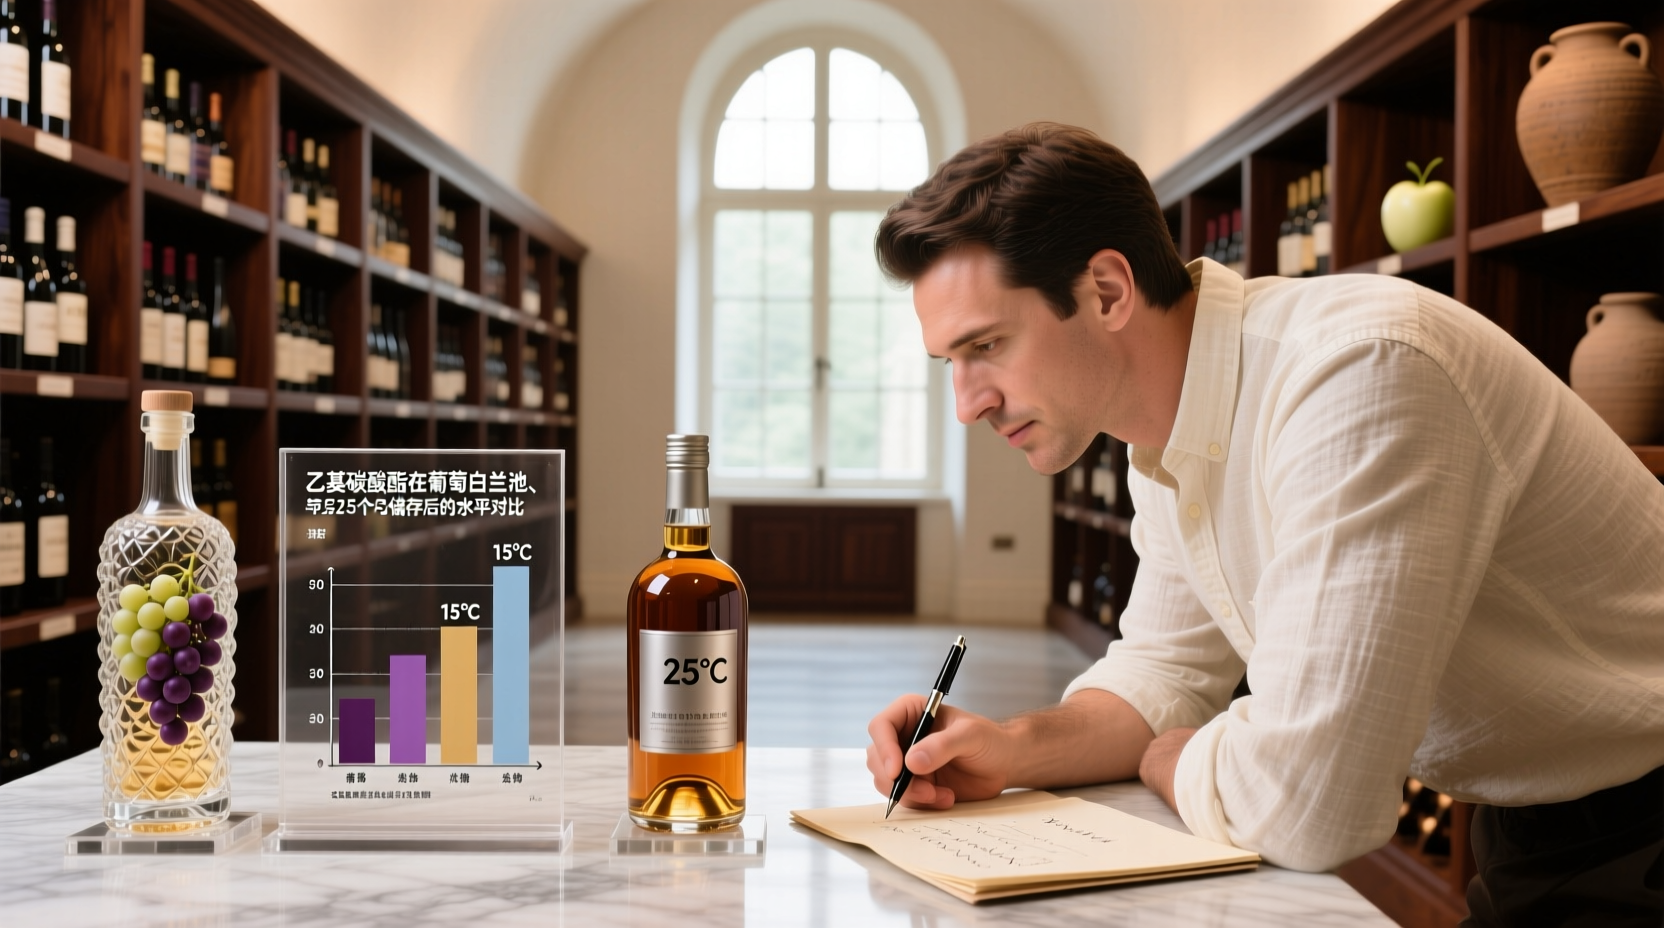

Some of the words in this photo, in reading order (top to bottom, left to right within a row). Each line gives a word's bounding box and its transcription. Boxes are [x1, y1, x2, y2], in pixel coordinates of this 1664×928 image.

[492, 543, 533, 561] 15°C
[440, 602, 481, 621] 15°C
[663, 657, 728, 685] 25°C
